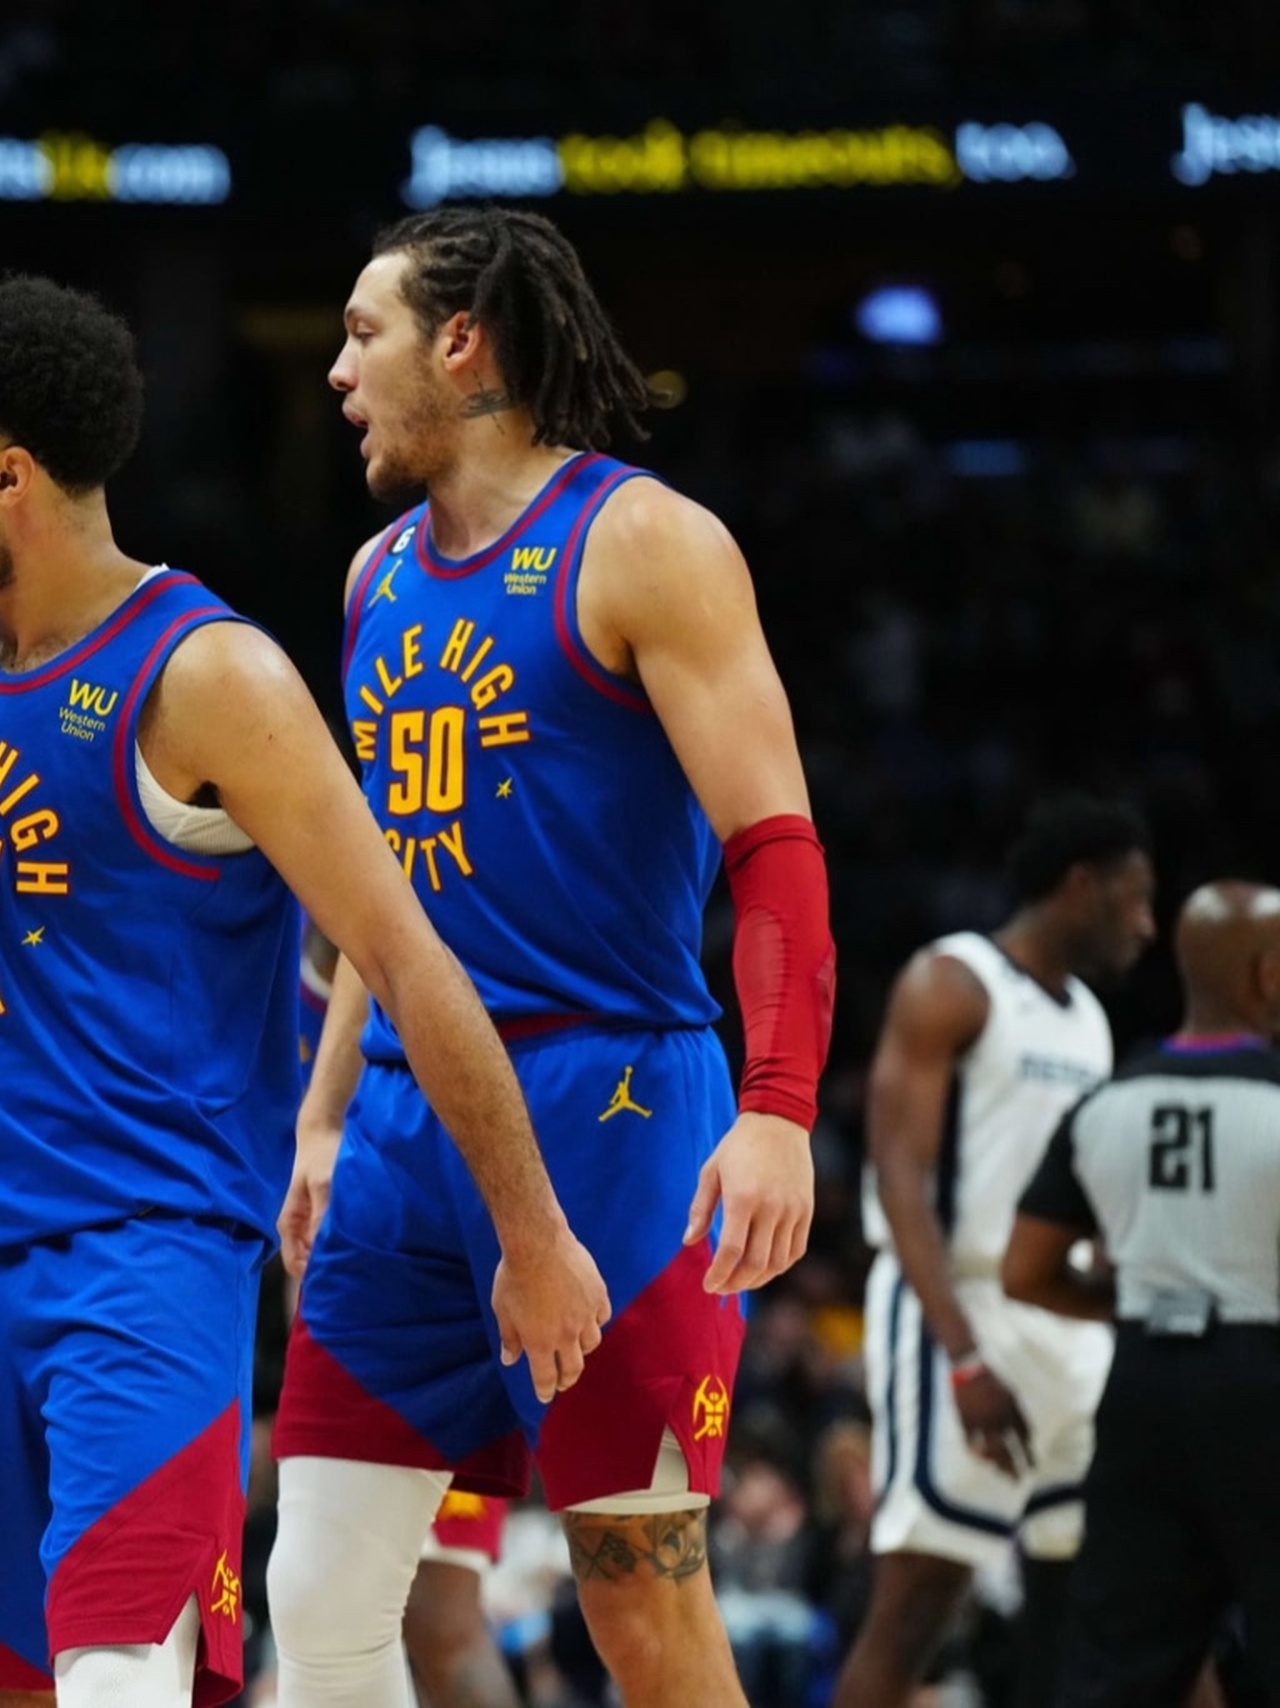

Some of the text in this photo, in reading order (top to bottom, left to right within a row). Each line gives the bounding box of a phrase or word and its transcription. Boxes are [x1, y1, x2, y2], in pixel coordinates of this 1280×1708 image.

[393, 526, 417, 553] 6
[511, 547, 558, 571] WU
[503, 573, 547, 585] Western
[506, 584, 537, 595] Union
[68, 678, 119, 717] WU
[351, 617, 530, 761] MILE HIGH
[58, 706, 106, 732] Western
[61, 721, 95, 743] Union
[386, 704, 466, 816] 50
[1148, 1103, 1217, 1193] 21
